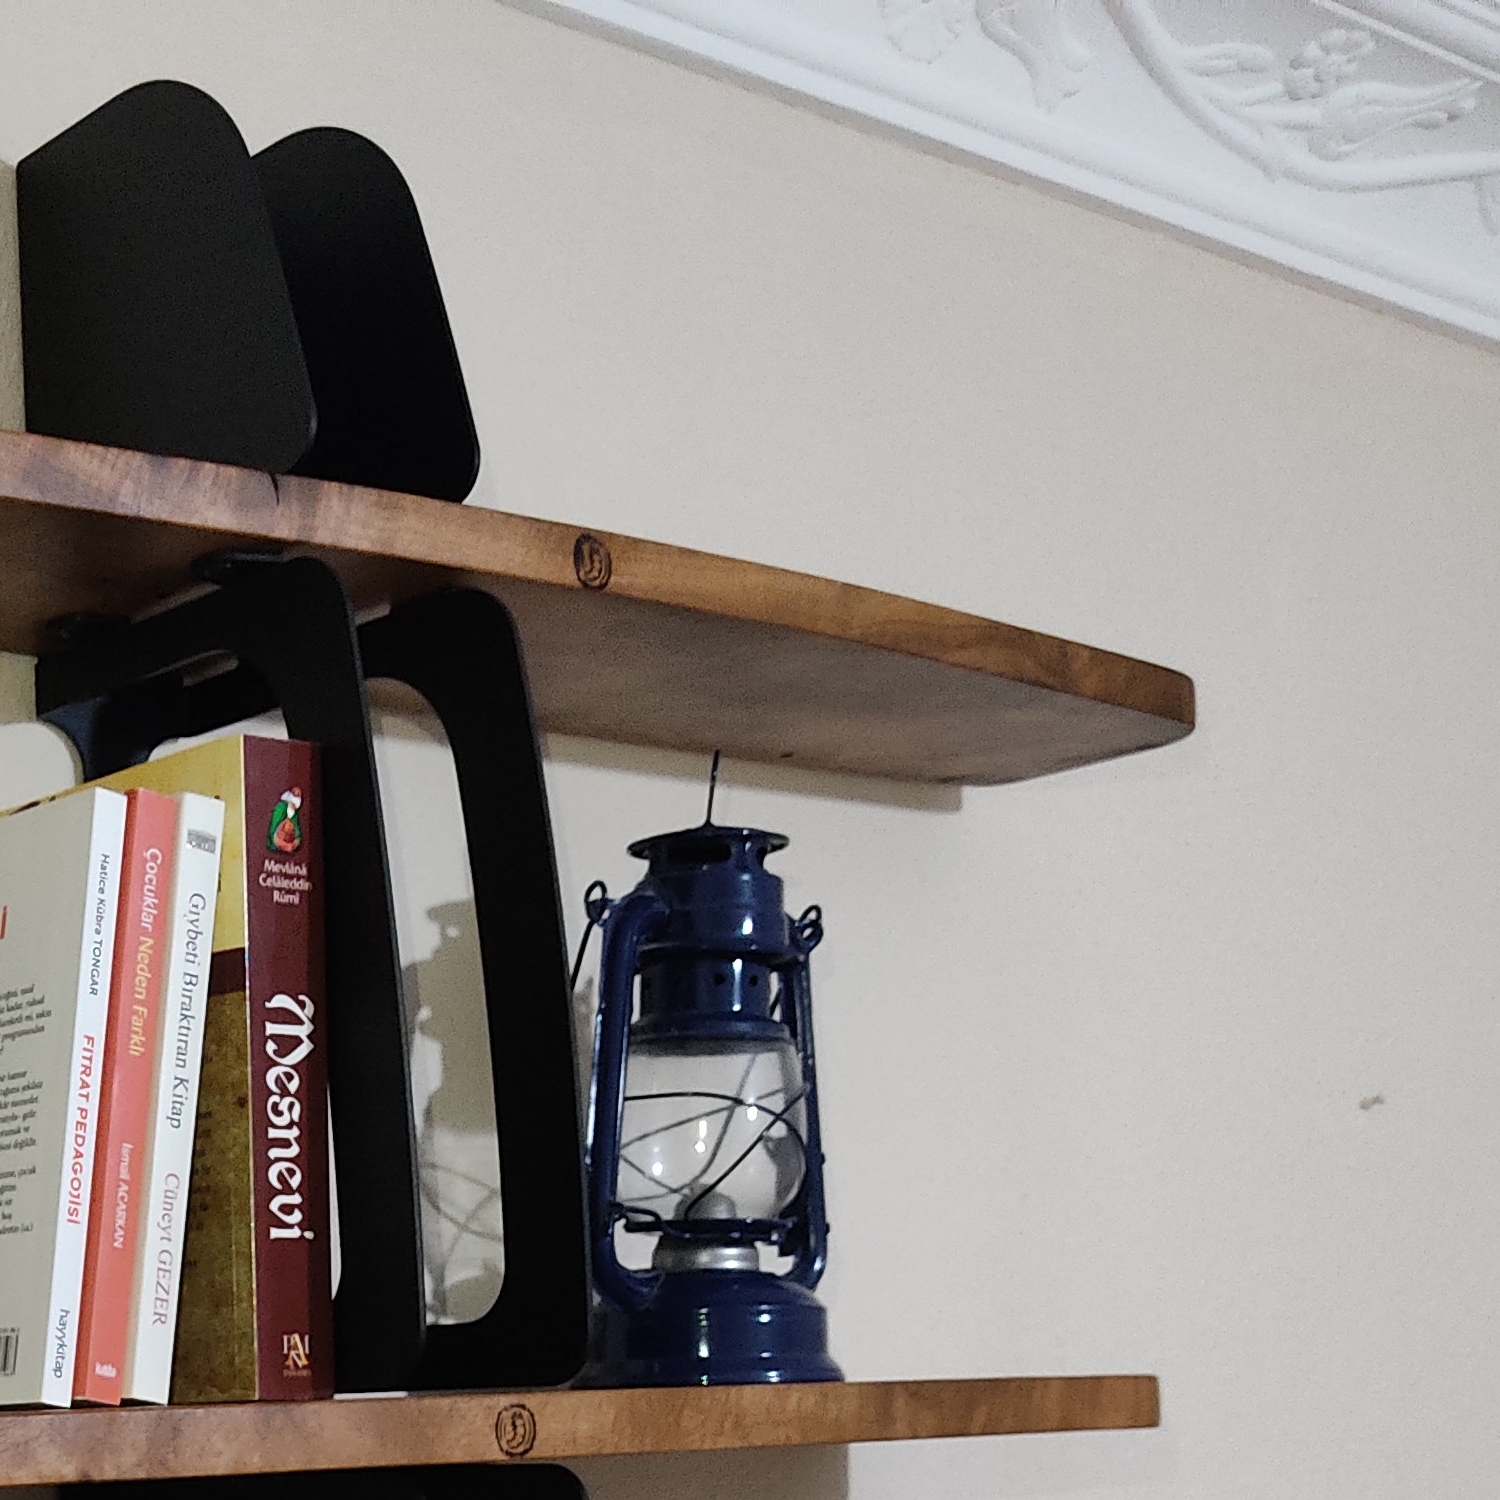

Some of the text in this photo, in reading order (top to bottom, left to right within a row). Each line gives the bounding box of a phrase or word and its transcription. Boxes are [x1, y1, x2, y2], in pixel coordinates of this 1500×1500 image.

[98, 853, 110, 895] Hatice
[94, 897, 105, 936] Kübra
[128, 847, 162, 1057] Çocuklar Neden Farklı
[89, 939, 103, 996] TONGAR
[166, 893, 206, 1130] Gıybeti Bıraktıran Kitap
[78, 1034, 95, 1102] FITRAT
[264, 993, 315, 1241] Mesnevi
[152, 1172, 180, 1325] Cüneyt GEZER
[52, 1308, 71, 1379] hayykitap
